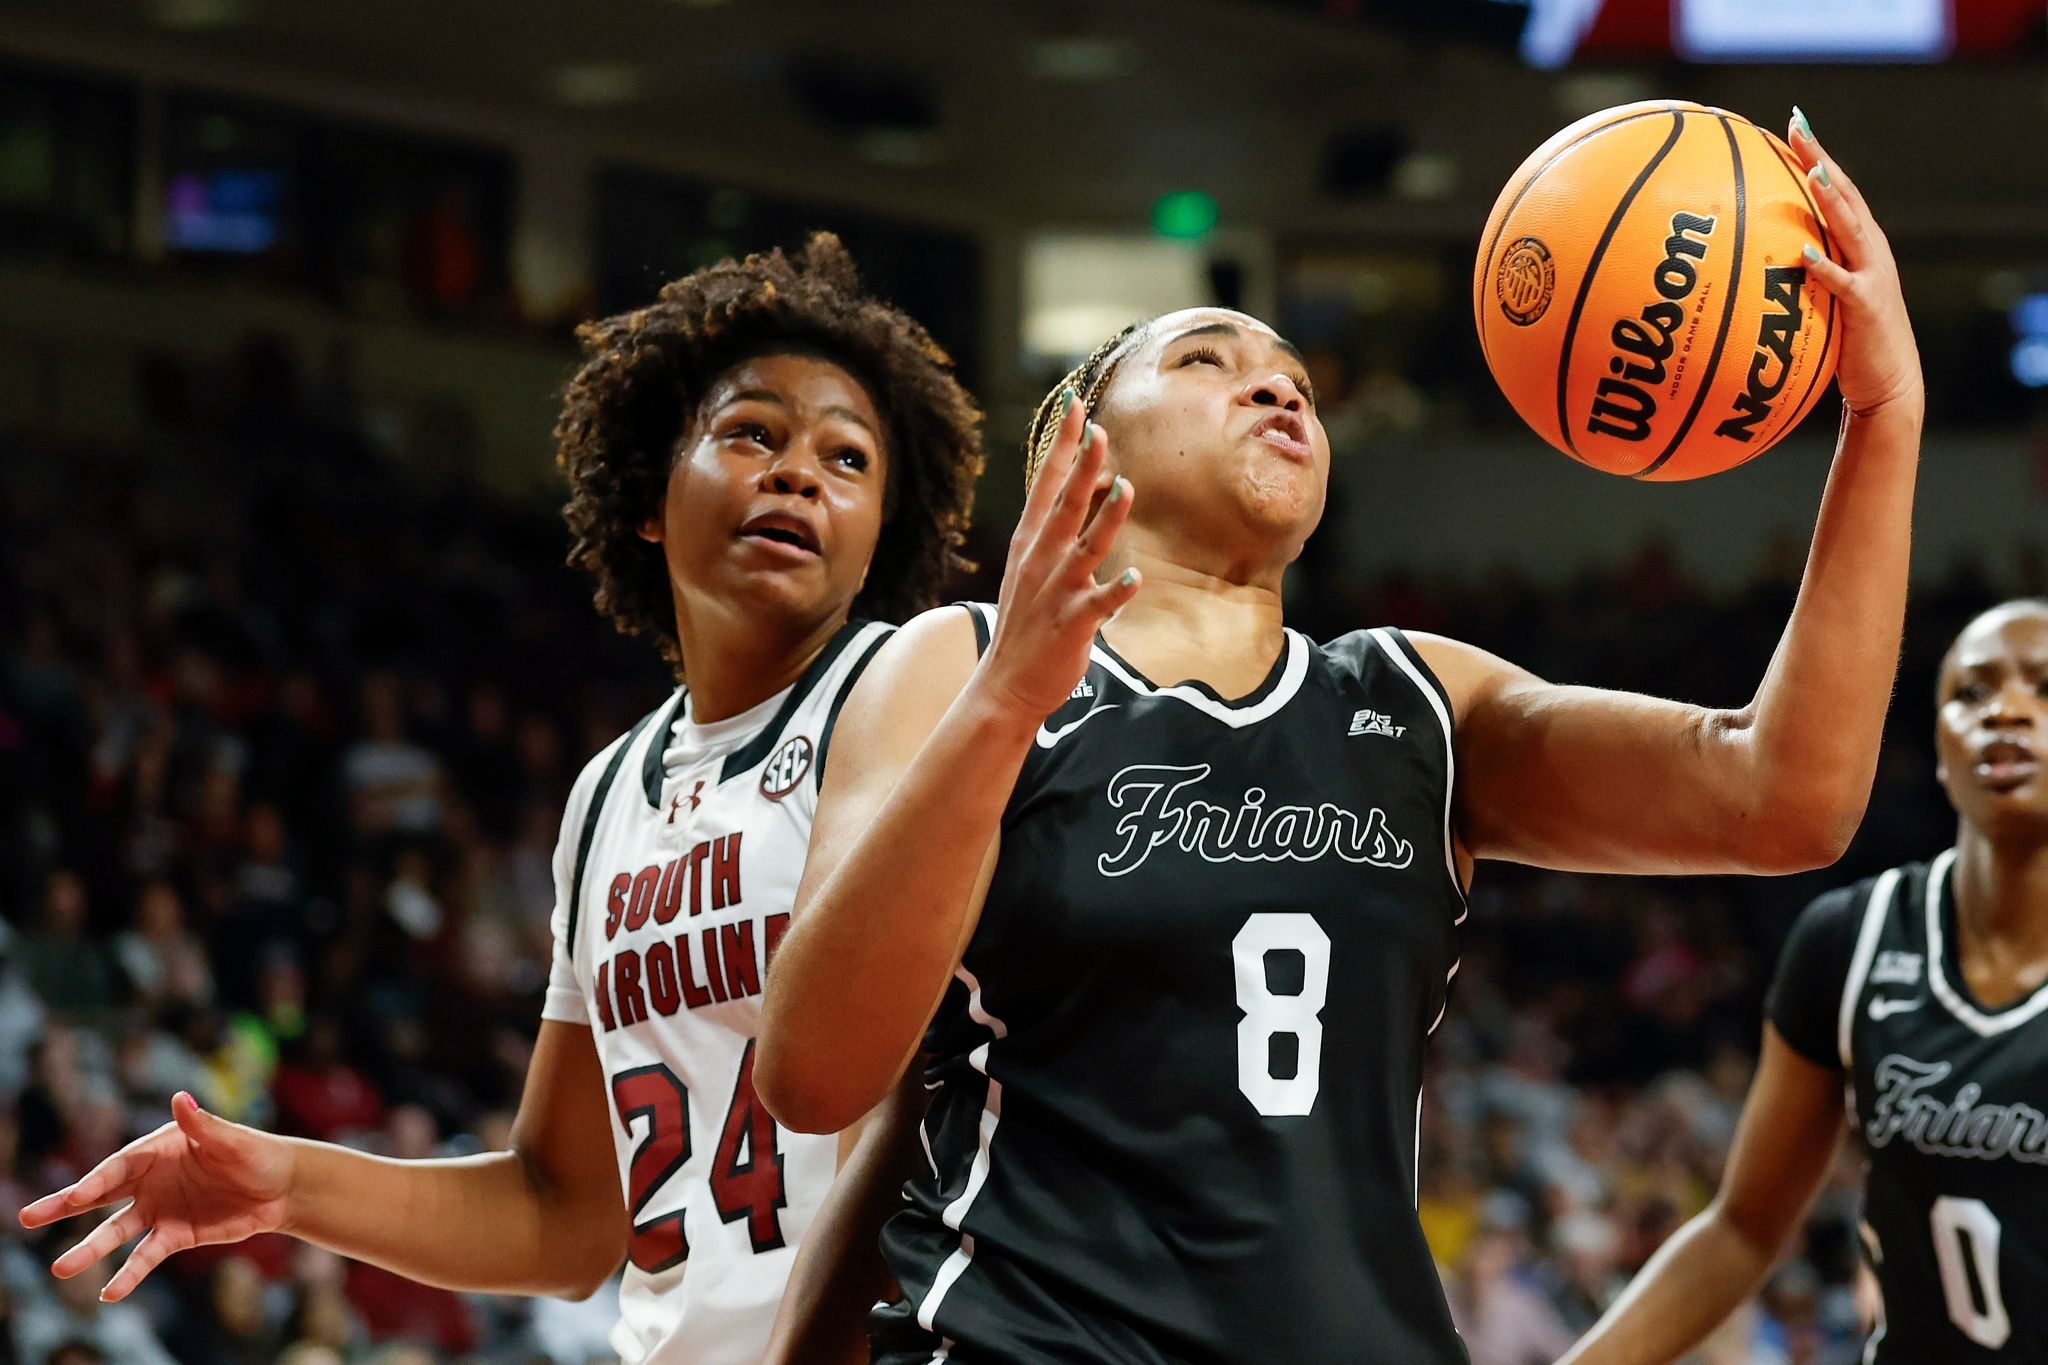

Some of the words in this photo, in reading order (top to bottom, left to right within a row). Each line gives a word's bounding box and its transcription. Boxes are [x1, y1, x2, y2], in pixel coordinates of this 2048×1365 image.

[1587, 210, 1715, 442] Wilson
[1669, 356, 1687, 400] INDOOR
[1683, 317, 1700, 353] GAME
[1696, 282, 1712, 313] BALL
[1714, 266, 1807, 443] NCAA
[762, 737, 811, 796] SEC
[1349, 720, 1407, 738] EAST
[1352, 708, 1392, 726] BIG
[1097, 762, 1415, 877] Friars
[605, 831, 744, 942] SOUTH
[1231, 912, 1332, 1117] 8
[611, 1036, 788, 1275] 24
[1866, 1052, 2048, 1166] Friar
[1929, 1194, 2012, 1351] 0
